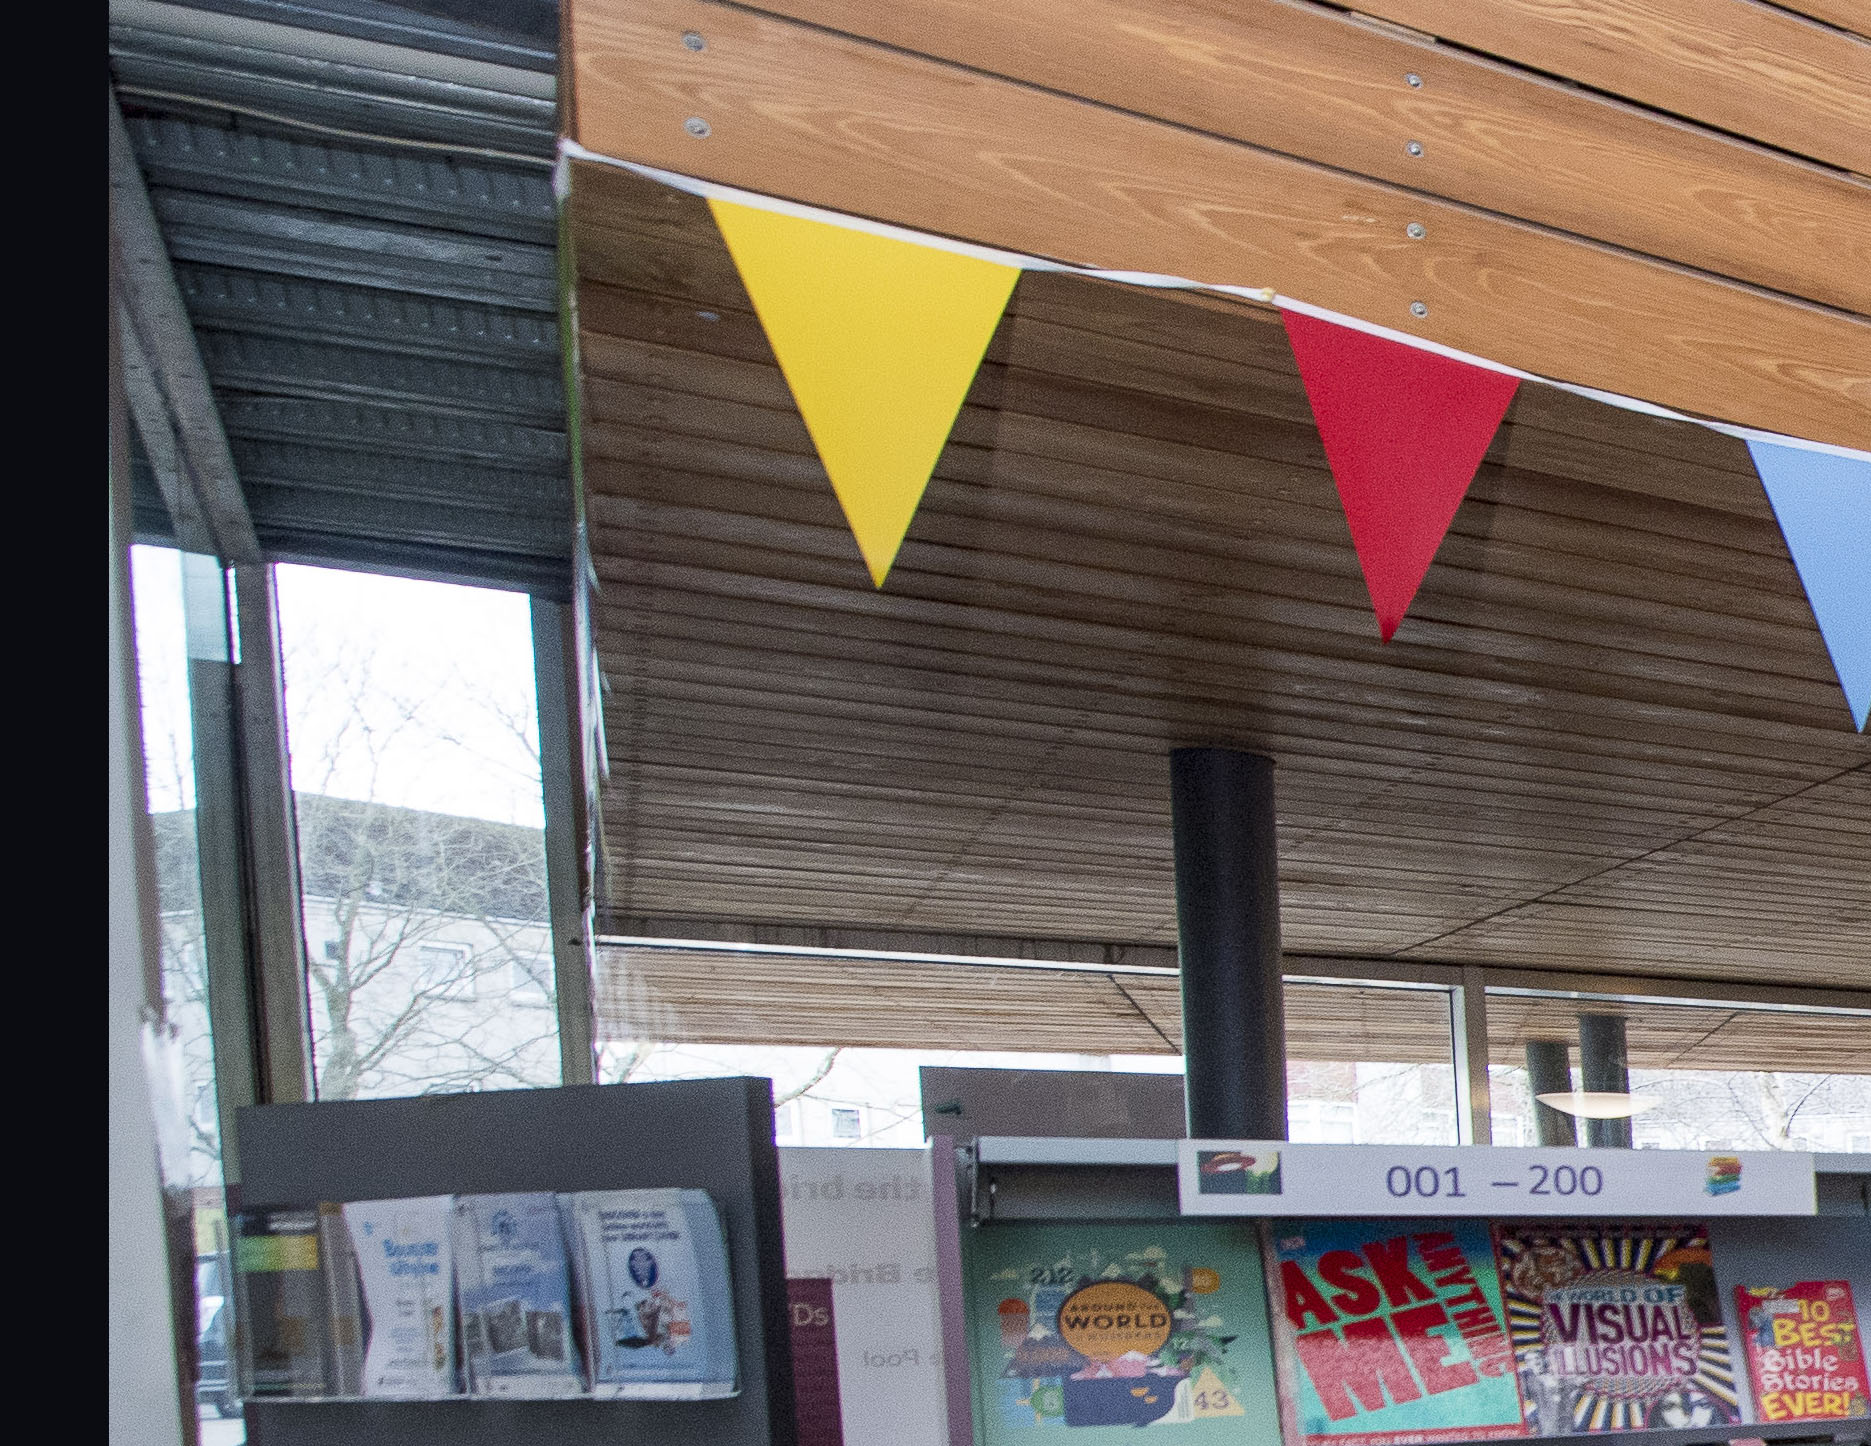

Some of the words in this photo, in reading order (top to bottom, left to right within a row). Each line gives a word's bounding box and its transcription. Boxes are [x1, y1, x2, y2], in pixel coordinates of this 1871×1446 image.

[1386, 1166, 1466, 1198] 001
[1529, 1164, 1603, 1196] 200
[1281, 1236, 1437, 1330] ASK
[1643, 1285, 1685, 1303] OF
[1064, 1313, 1167, 1331] WORLD
[1550, 1303, 1692, 1345] VISUAL
[1296, 1303, 1480, 1422] ME
[1760, 1349, 1839, 1372] Bible
[1761, 1371, 1859, 1391] Stories
[1194, 1389, 1229, 1411] 43
[1761, 1391, 1850, 1420] EVER!
